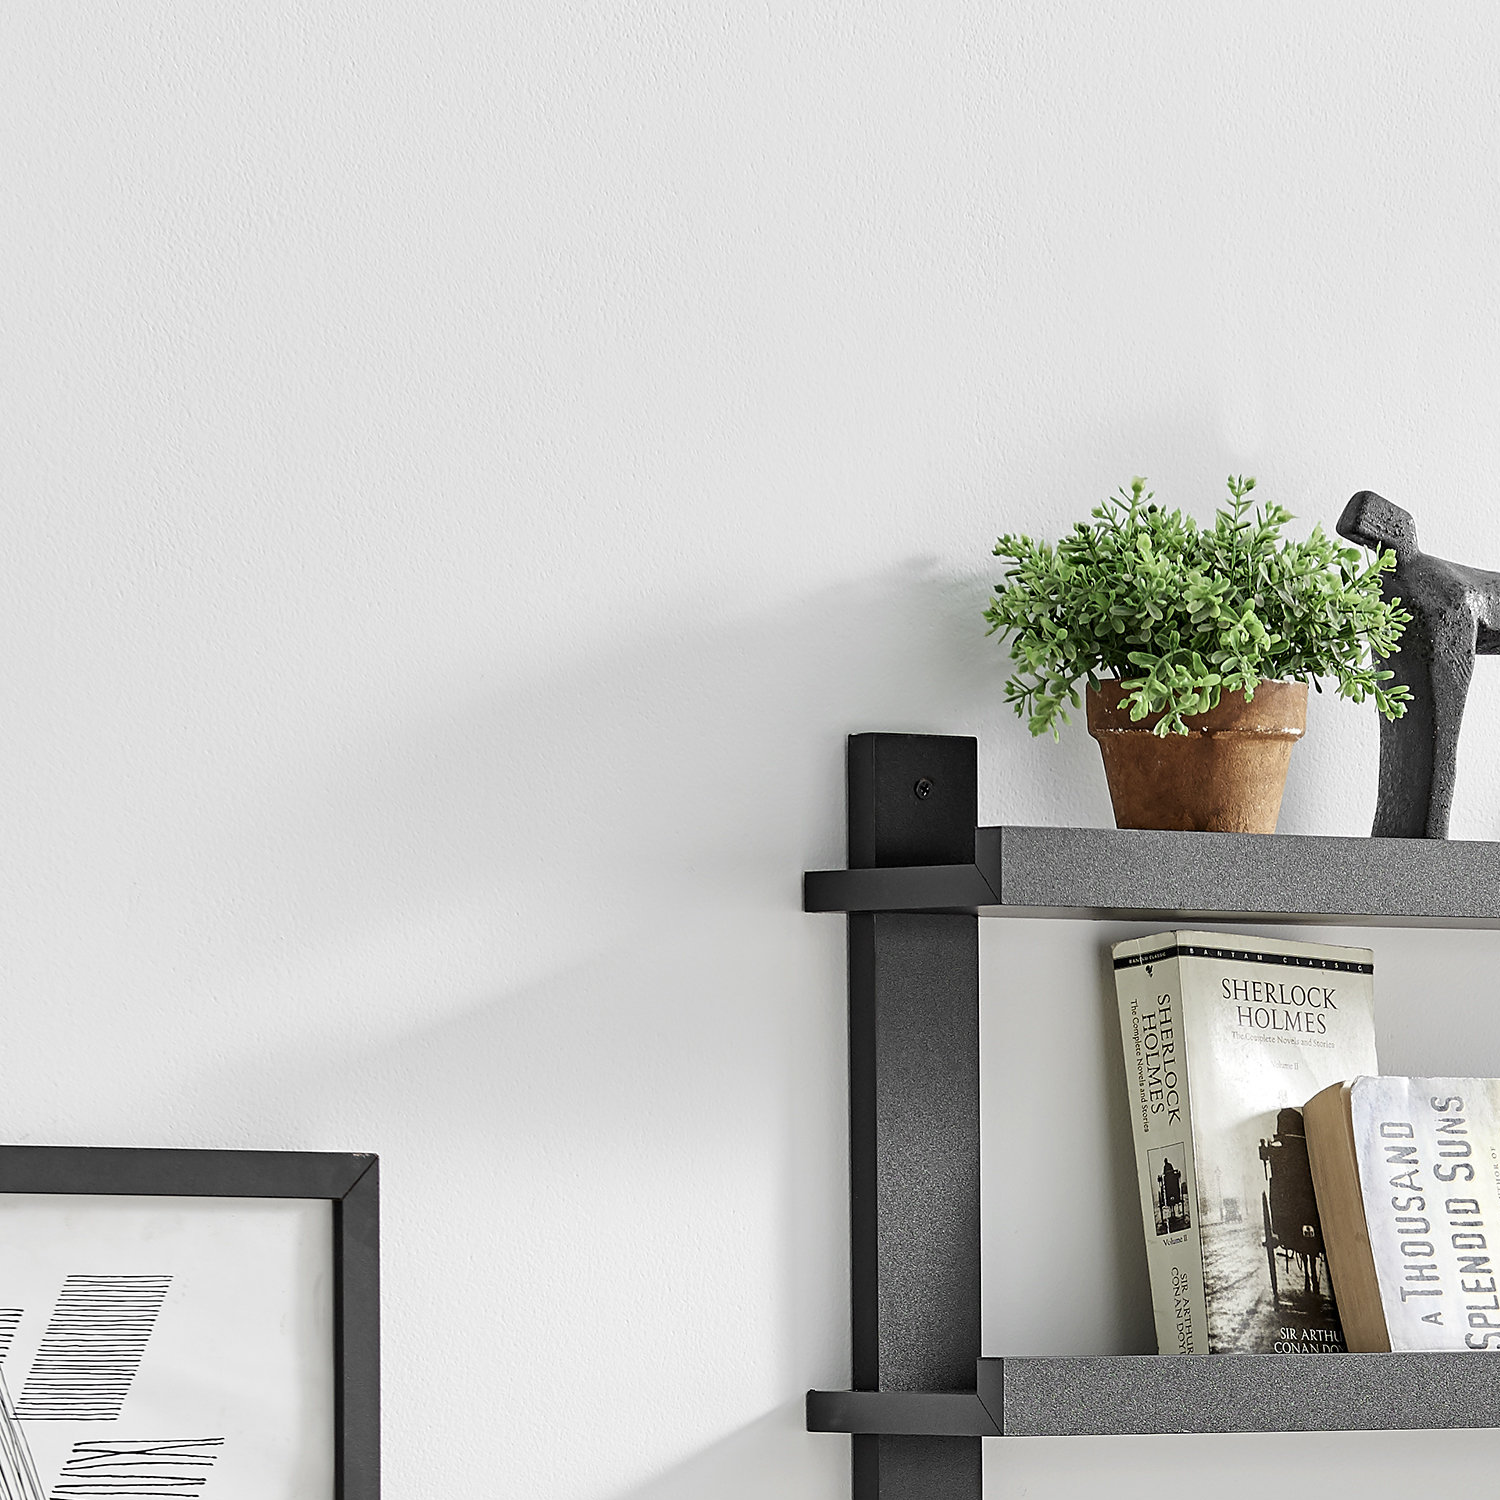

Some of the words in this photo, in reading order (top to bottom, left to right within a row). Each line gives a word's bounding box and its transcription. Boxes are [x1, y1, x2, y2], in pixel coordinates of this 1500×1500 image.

[1189, 948, 1263, 961] BANTAM
[1282, 957, 1363, 972] CLASSIC
[1130, 998, 1139, 1015] The
[1222, 978, 1338, 1009] SHERLOCK
[1236, 1006, 1327, 1034] HOLMES
[1132, 1017, 1142, 1056] Complete
[1231, 1031, 1245, 1040] The
[1245, 1033, 1275, 1045] Complete
[1277, 1036, 1299, 1046] Novels
[1300, 1038, 1312, 1047] and
[1313, 1039, 1335, 1049] Stories
[1136, 1058, 1146, 1086] Novels
[1141, 1012, 1165, 1114] HOLMES
[1157, 994, 1181, 1126] SHERLOCK
[1140, 1088, 1148, 1103] and
[1141, 1104, 1149, 1132] Stories
[1430, 1096, 1475, 1181] SUNS
[1490, 1145, 1498, 1160] OF
[1380, 1122, 1443, 1302] THOUSAND
[1163, 1236, 1183, 1247] Volume
[1171, 1267, 1182, 1318] CONAN
[1180, 1273, 1188, 1293] SIR
[1182, 1297, 1194, 1354] ARTHUR
[1421, 1311, 1444, 1326] A
[1176, 1322, 1187, 1354] DOYL
[1274, 1341, 1320, 1354] CONAN
[1280, 1327, 1297, 1340] SIR
[1301, 1328, 1342, 1343] ARTHU
